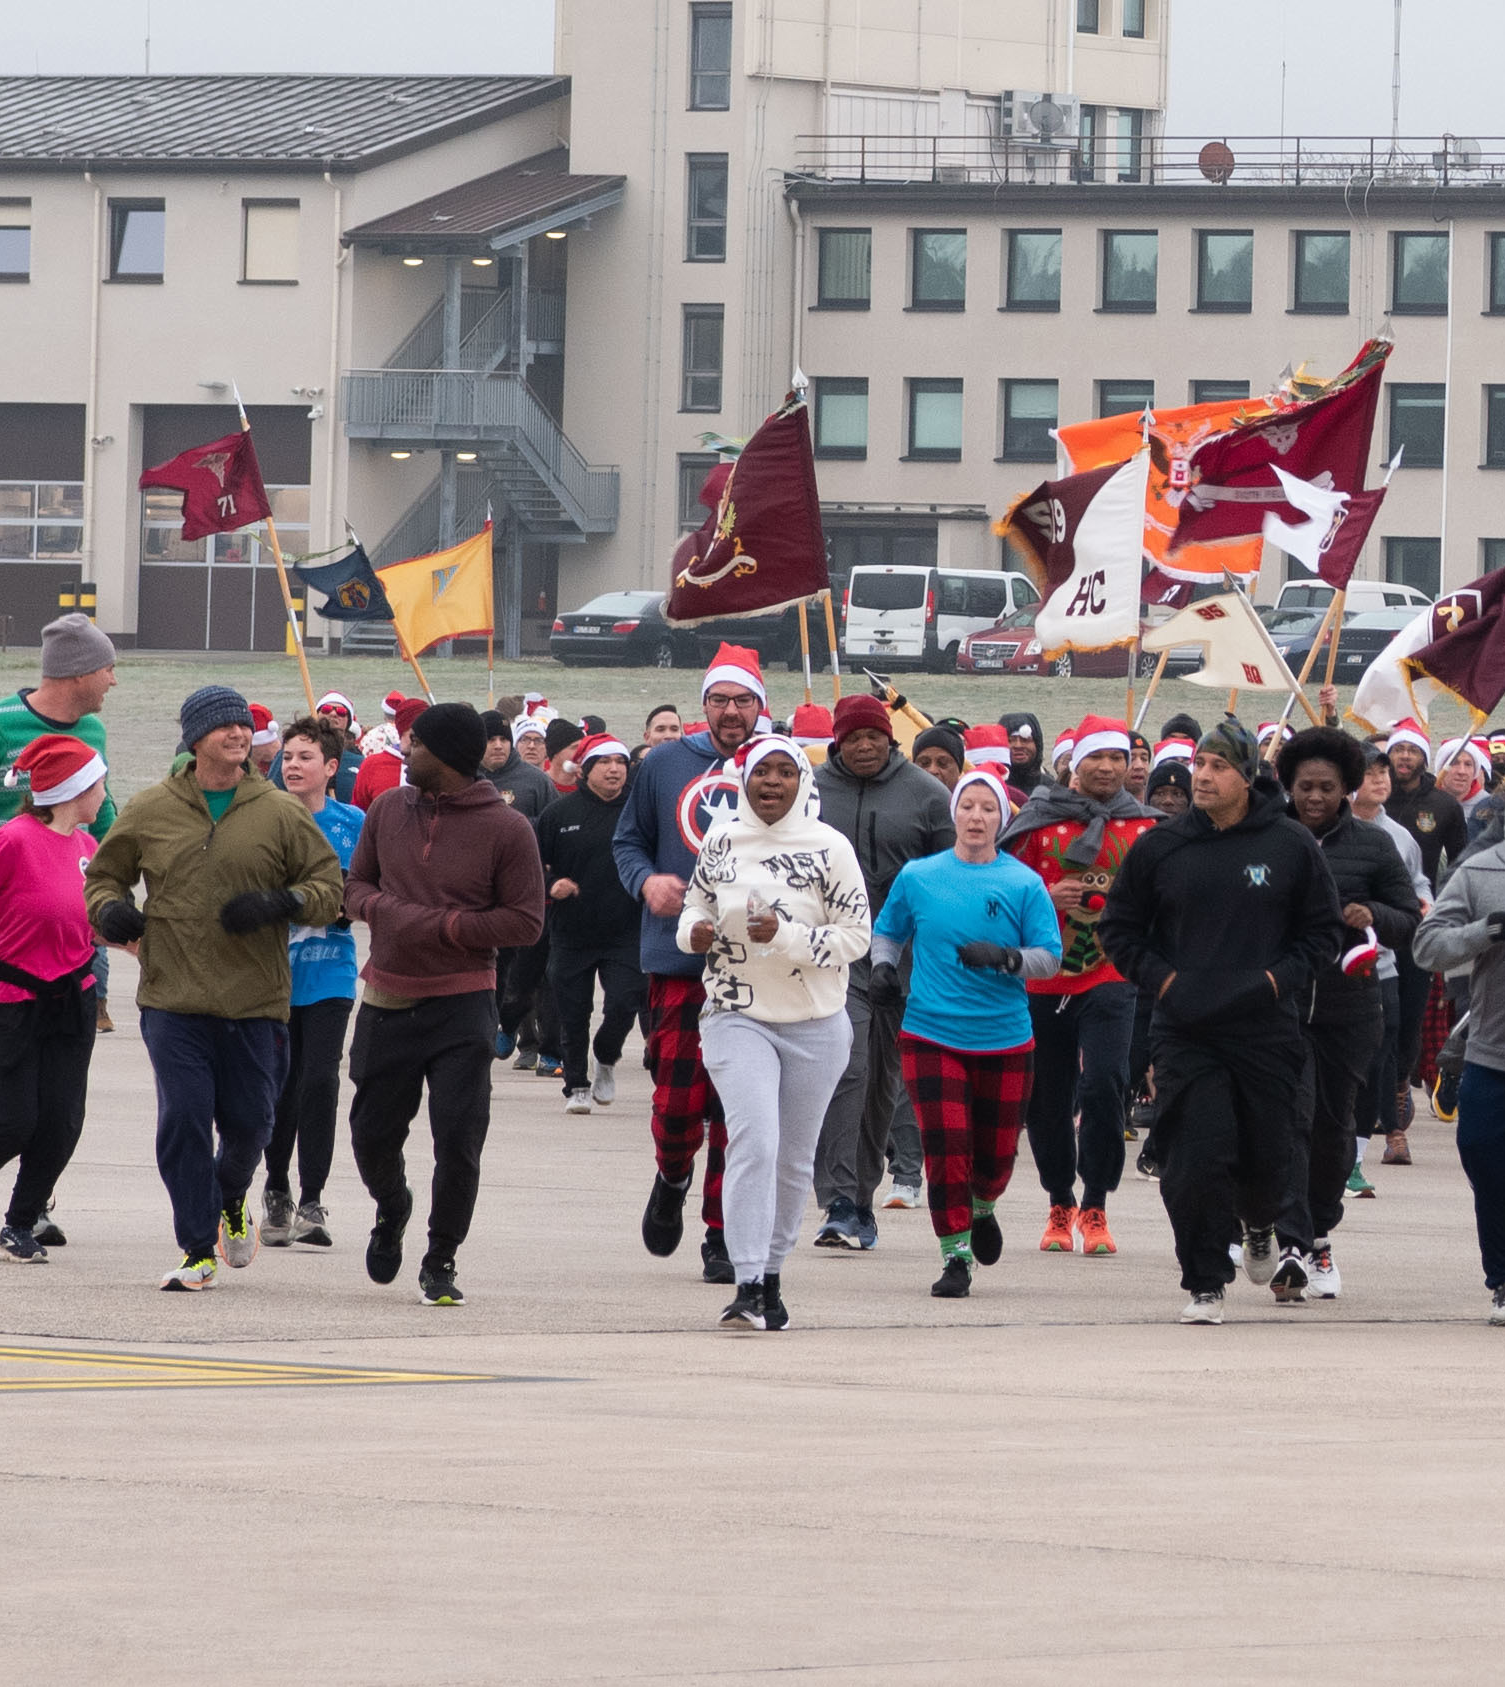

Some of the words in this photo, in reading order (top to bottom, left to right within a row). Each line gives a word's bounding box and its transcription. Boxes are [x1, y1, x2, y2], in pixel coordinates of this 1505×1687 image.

[217, 495, 237, 518] 71
[1065, 569, 1106, 616] HC
[1195, 603, 1226, 621] 95
